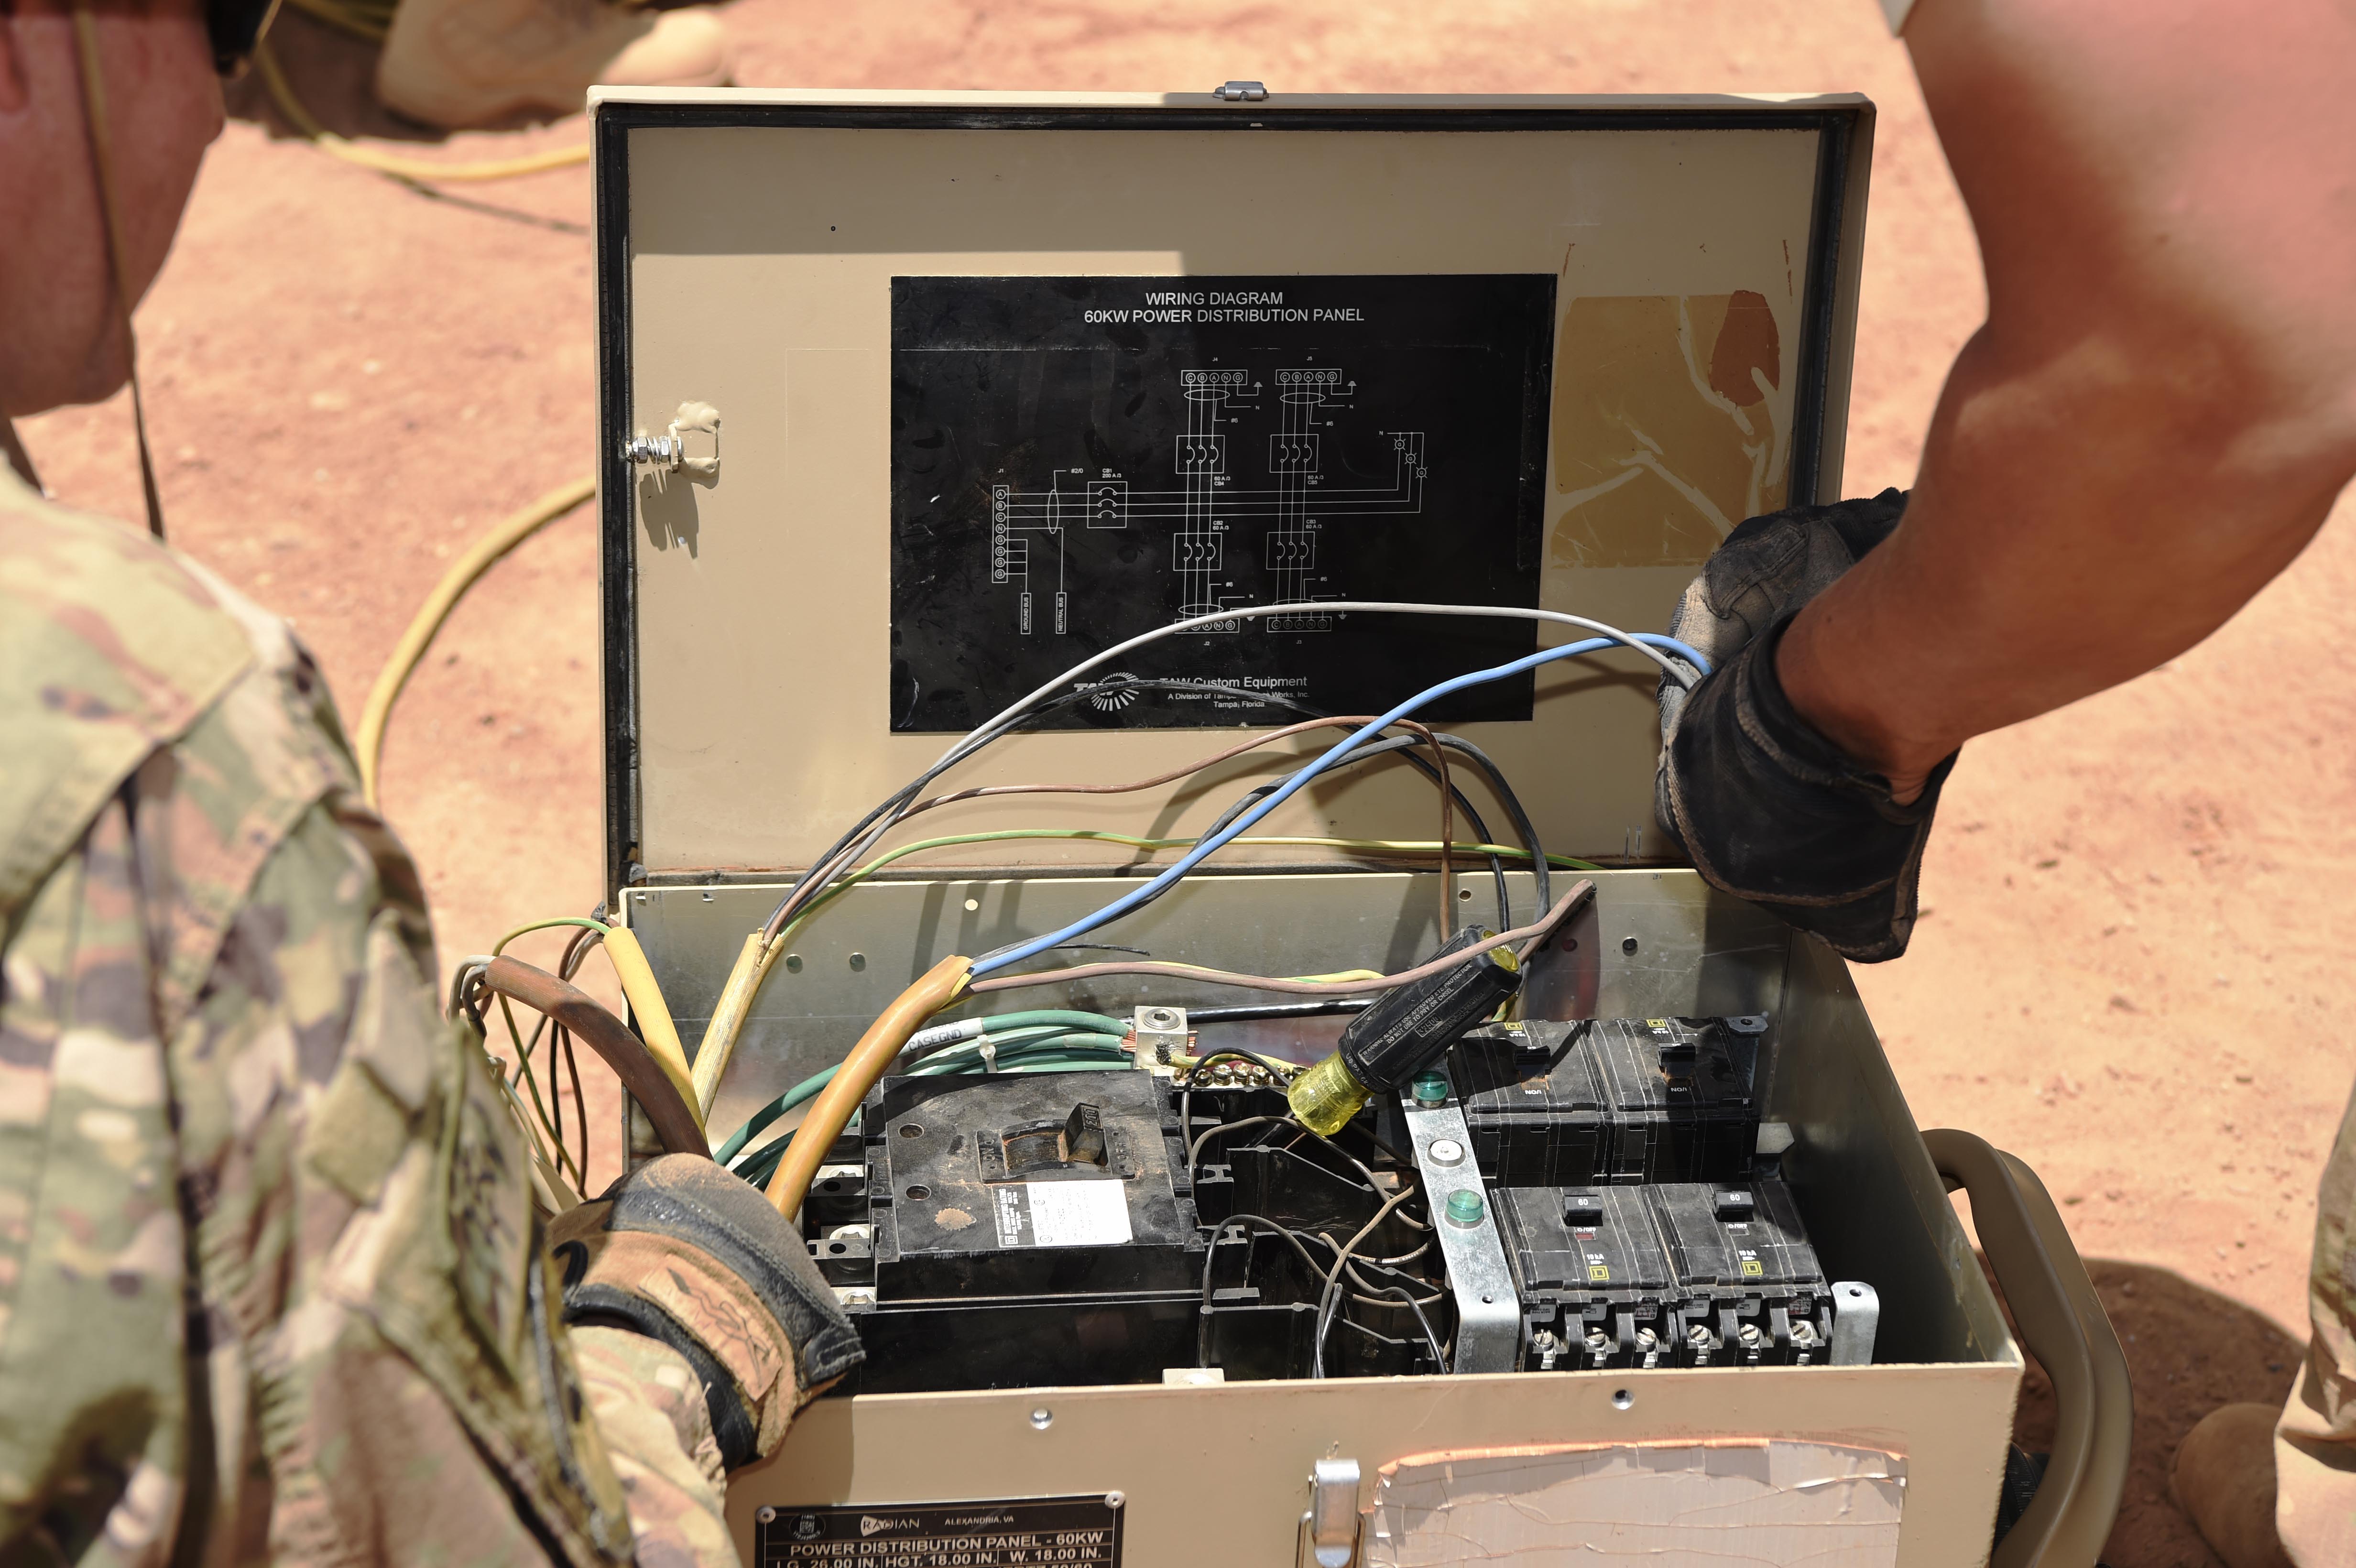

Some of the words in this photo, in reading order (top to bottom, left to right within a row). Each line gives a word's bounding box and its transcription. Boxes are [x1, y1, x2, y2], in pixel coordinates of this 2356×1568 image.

[1145, 293, 1205, 305] WIRING
[1210, 292, 1283, 305] DIAGRAM
[1084, 310, 1129, 323] 60KW
[1133, 310, 1192, 322] POWER
[1197, 309, 1308, 322] DISTRIBUTION
[1313, 309, 1364, 321] PANEL
[1194, 677, 1240, 687] Custom
[1244, 676, 1307, 689] Equipment
[1383, 1022, 1402, 1039] ALWAYS
[1402, 1015, 1411, 1024] USE
[1411, 995, 1435, 1016] APPROVED
[1386, 1036, 1395, 1044] DO
[1395, 1029, 1404, 1038] NOT
[1405, 1021, 1413, 1030] USE
[1421, 1007, 1430, 1016] PRY
[908, 1029, 962, 1051] CASEGND
[1000, 1204, 1012, 1234] INTERRUPTING
[863, 1518, 920, 1529] RADIAN
[945, 1516, 1002, 1526] ALEXANDRIA,
[790, 1543, 855, 1556] POWER
[861, 1537, 982, 1554] DISTRIBUTION
[986, 1534, 1041, 1549] PANEL
[1057, 1531, 1103, 1545] 60KW
[886, 1555, 923, 1567] HGT.
[929, 1553, 971, 1566] 18.00
[976, 1552, 996, 1564] IN.
[1010, 1550, 1028, 1563] W.
[1035, 1548, 1076, 1561] 18.00
[1081, 1547, 1102, 1558] IN.
